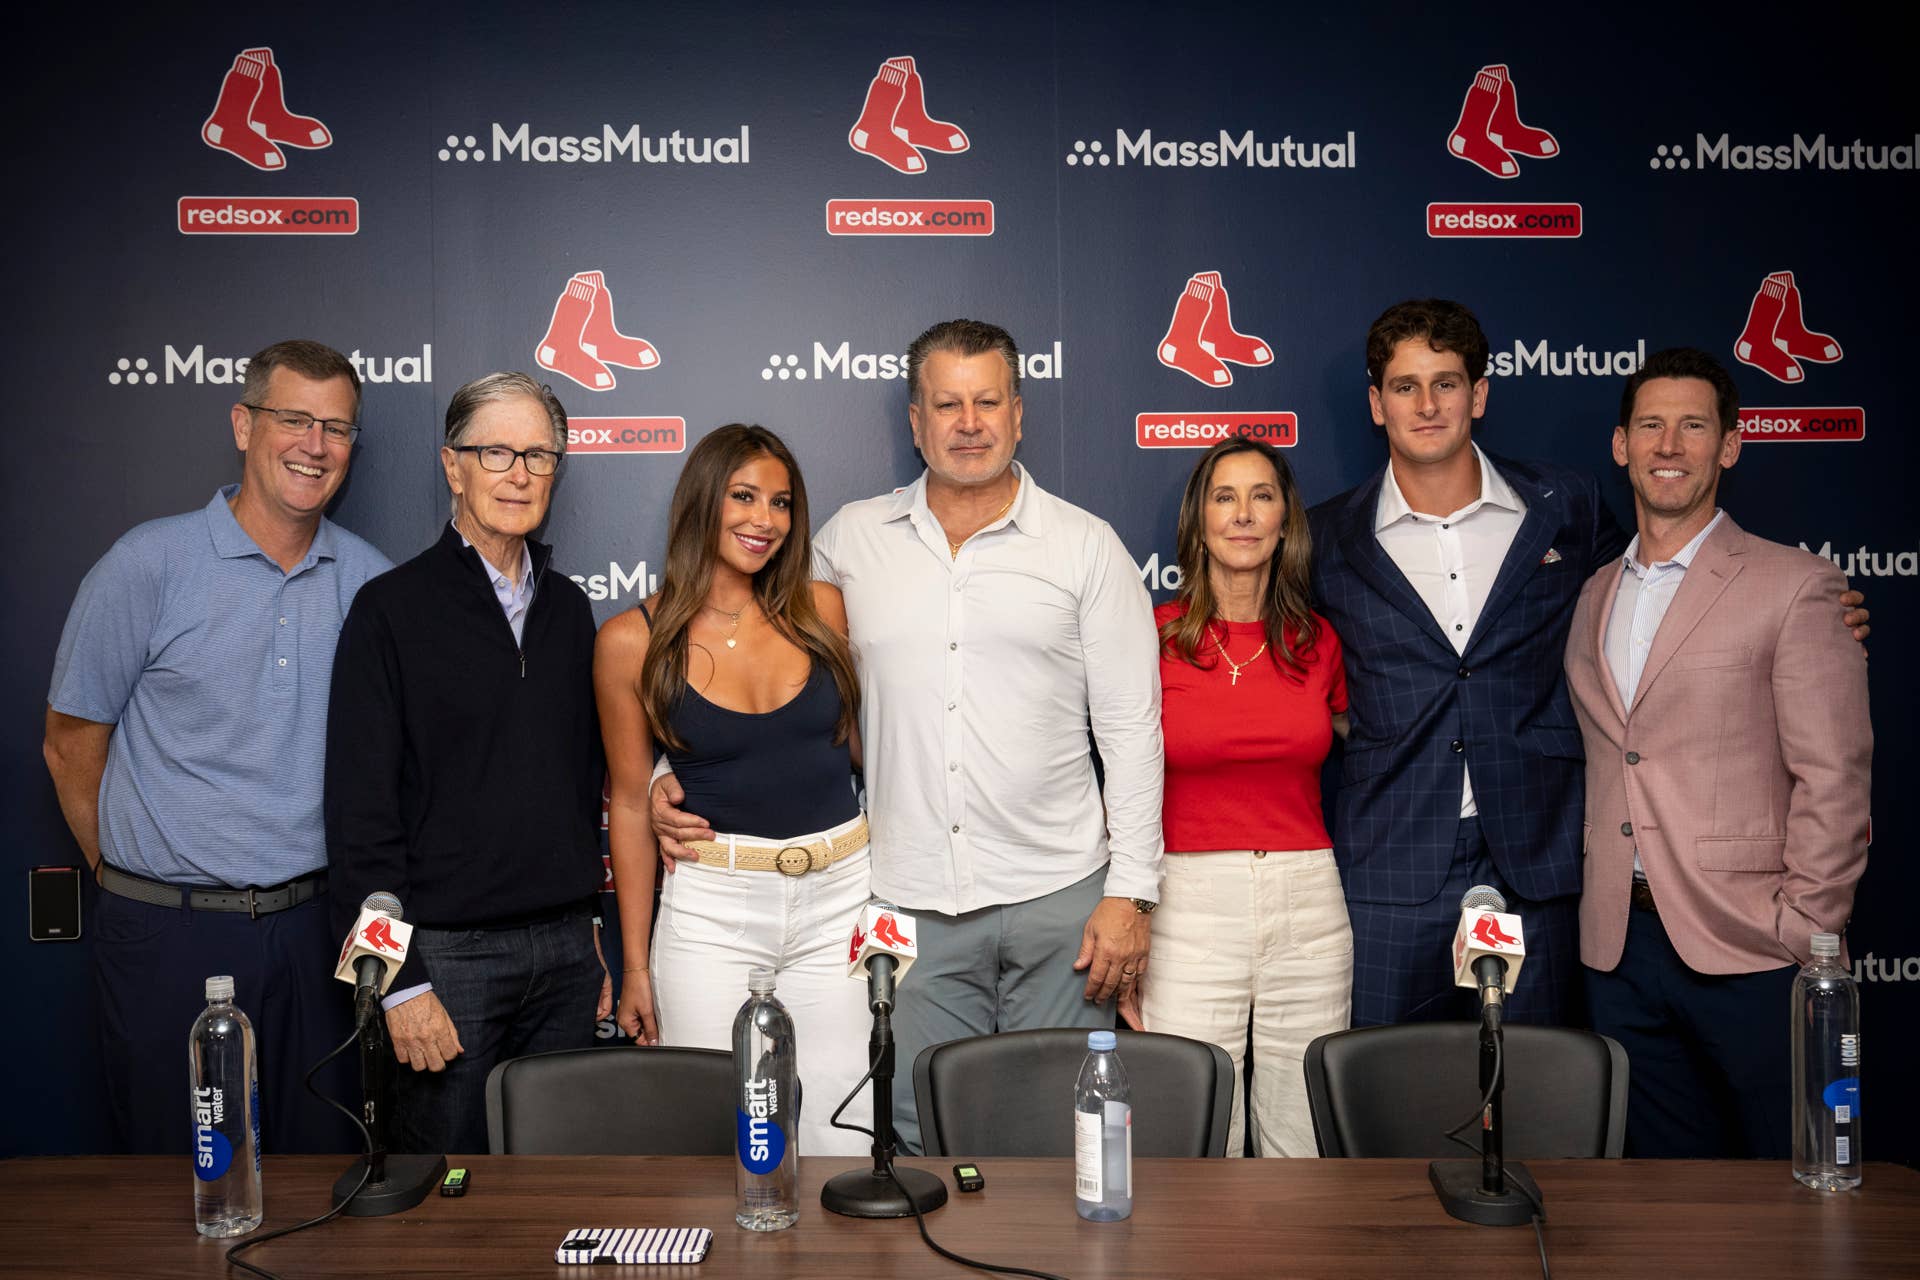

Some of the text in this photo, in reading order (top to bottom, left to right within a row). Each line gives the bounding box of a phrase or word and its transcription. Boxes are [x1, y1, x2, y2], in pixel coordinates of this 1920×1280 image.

[492, 123, 749, 164] MassMutual
[1116, 129, 1355, 169] MassMutual
[1696, 133, 1920, 170] MassMutual
[187, 204, 349, 227] redsox.com
[834, 206, 986, 228] redsox.com
[1434, 210, 1574, 230] redsox.com
[165, 344, 432, 384] Mastual
[567, 428, 676, 444] sox.com
[1144, 420, 1290, 439] redsox.com
[1737, 415, 1857, 433] edsox.com
[211, 1087, 224, 1125] water
[767, 1078, 778, 1116] water
[193, 1086, 214, 1168] smart
[744, 1078, 769, 1162] smart
